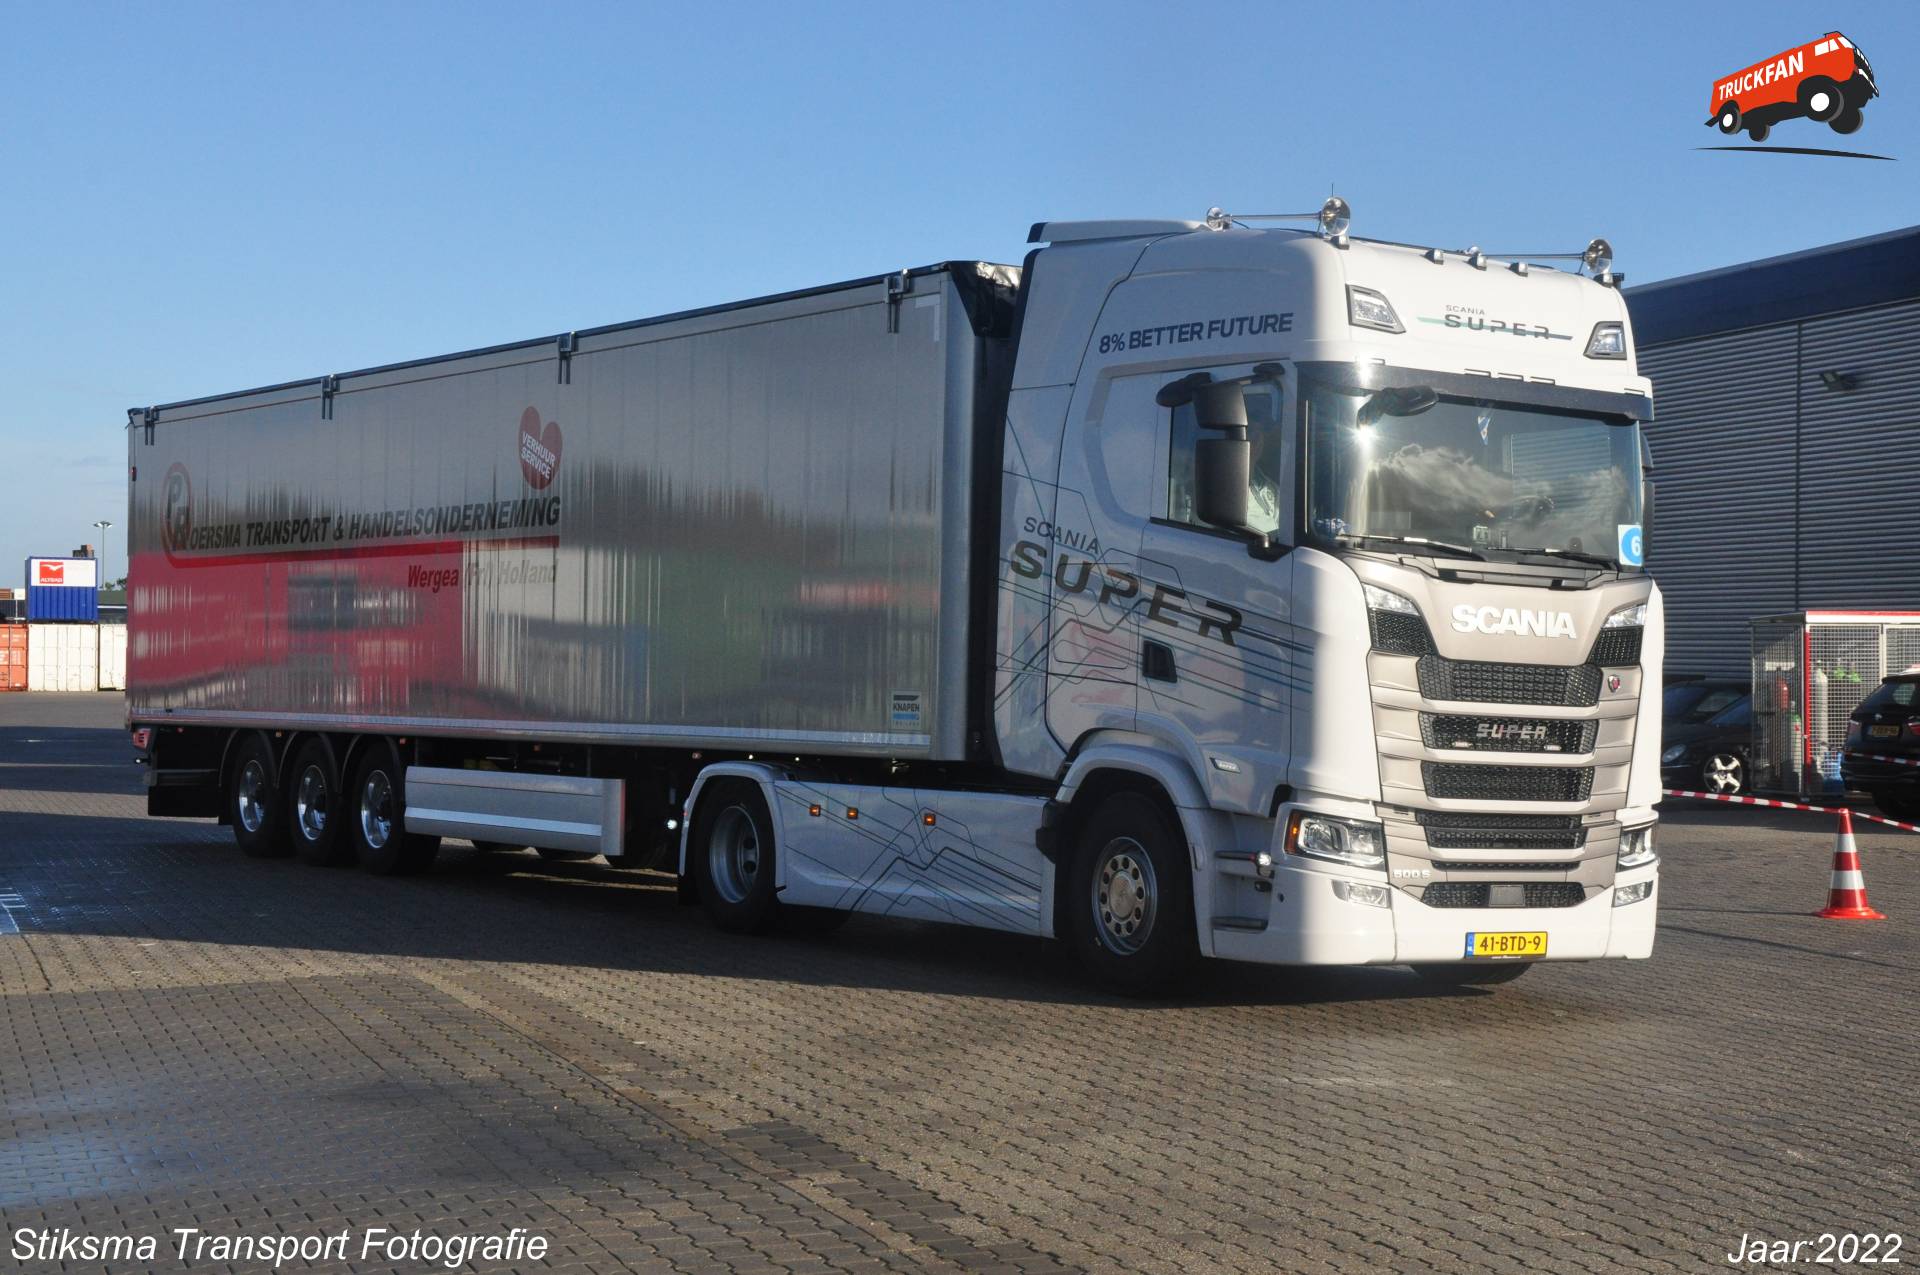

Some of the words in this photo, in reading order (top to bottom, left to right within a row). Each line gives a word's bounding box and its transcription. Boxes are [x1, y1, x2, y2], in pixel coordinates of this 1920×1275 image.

[1444, 314, 1550, 340] SUPER
[1445, 304, 1486, 316] SCANIA
[1099, 332, 1125, 354] 8%
[1129, 322, 1204, 350] BETTER
[1207, 312, 1294, 340] FUTURE
[521, 446, 551, 480] SERVICE
[522, 431, 556, 468] VERHUUR
[246, 516, 331, 547] TRANSPORT
[332, 514, 345, 541] &
[349, 496, 560, 539] HANDELSONDERNEMING
[1023, 517, 1100, 554] SCANIA
[1631, 535, 1641, 557] 6
[407, 564, 459, 593] Wergea
[499, 558, 559, 585] Holland
[1010, 540, 1243, 647] SUPER
[1451, 604, 1577, 639] SCANIA
[1476, 723, 1548, 740] SUPER
[1480, 935, 1541, 952] 41-BTD-9
